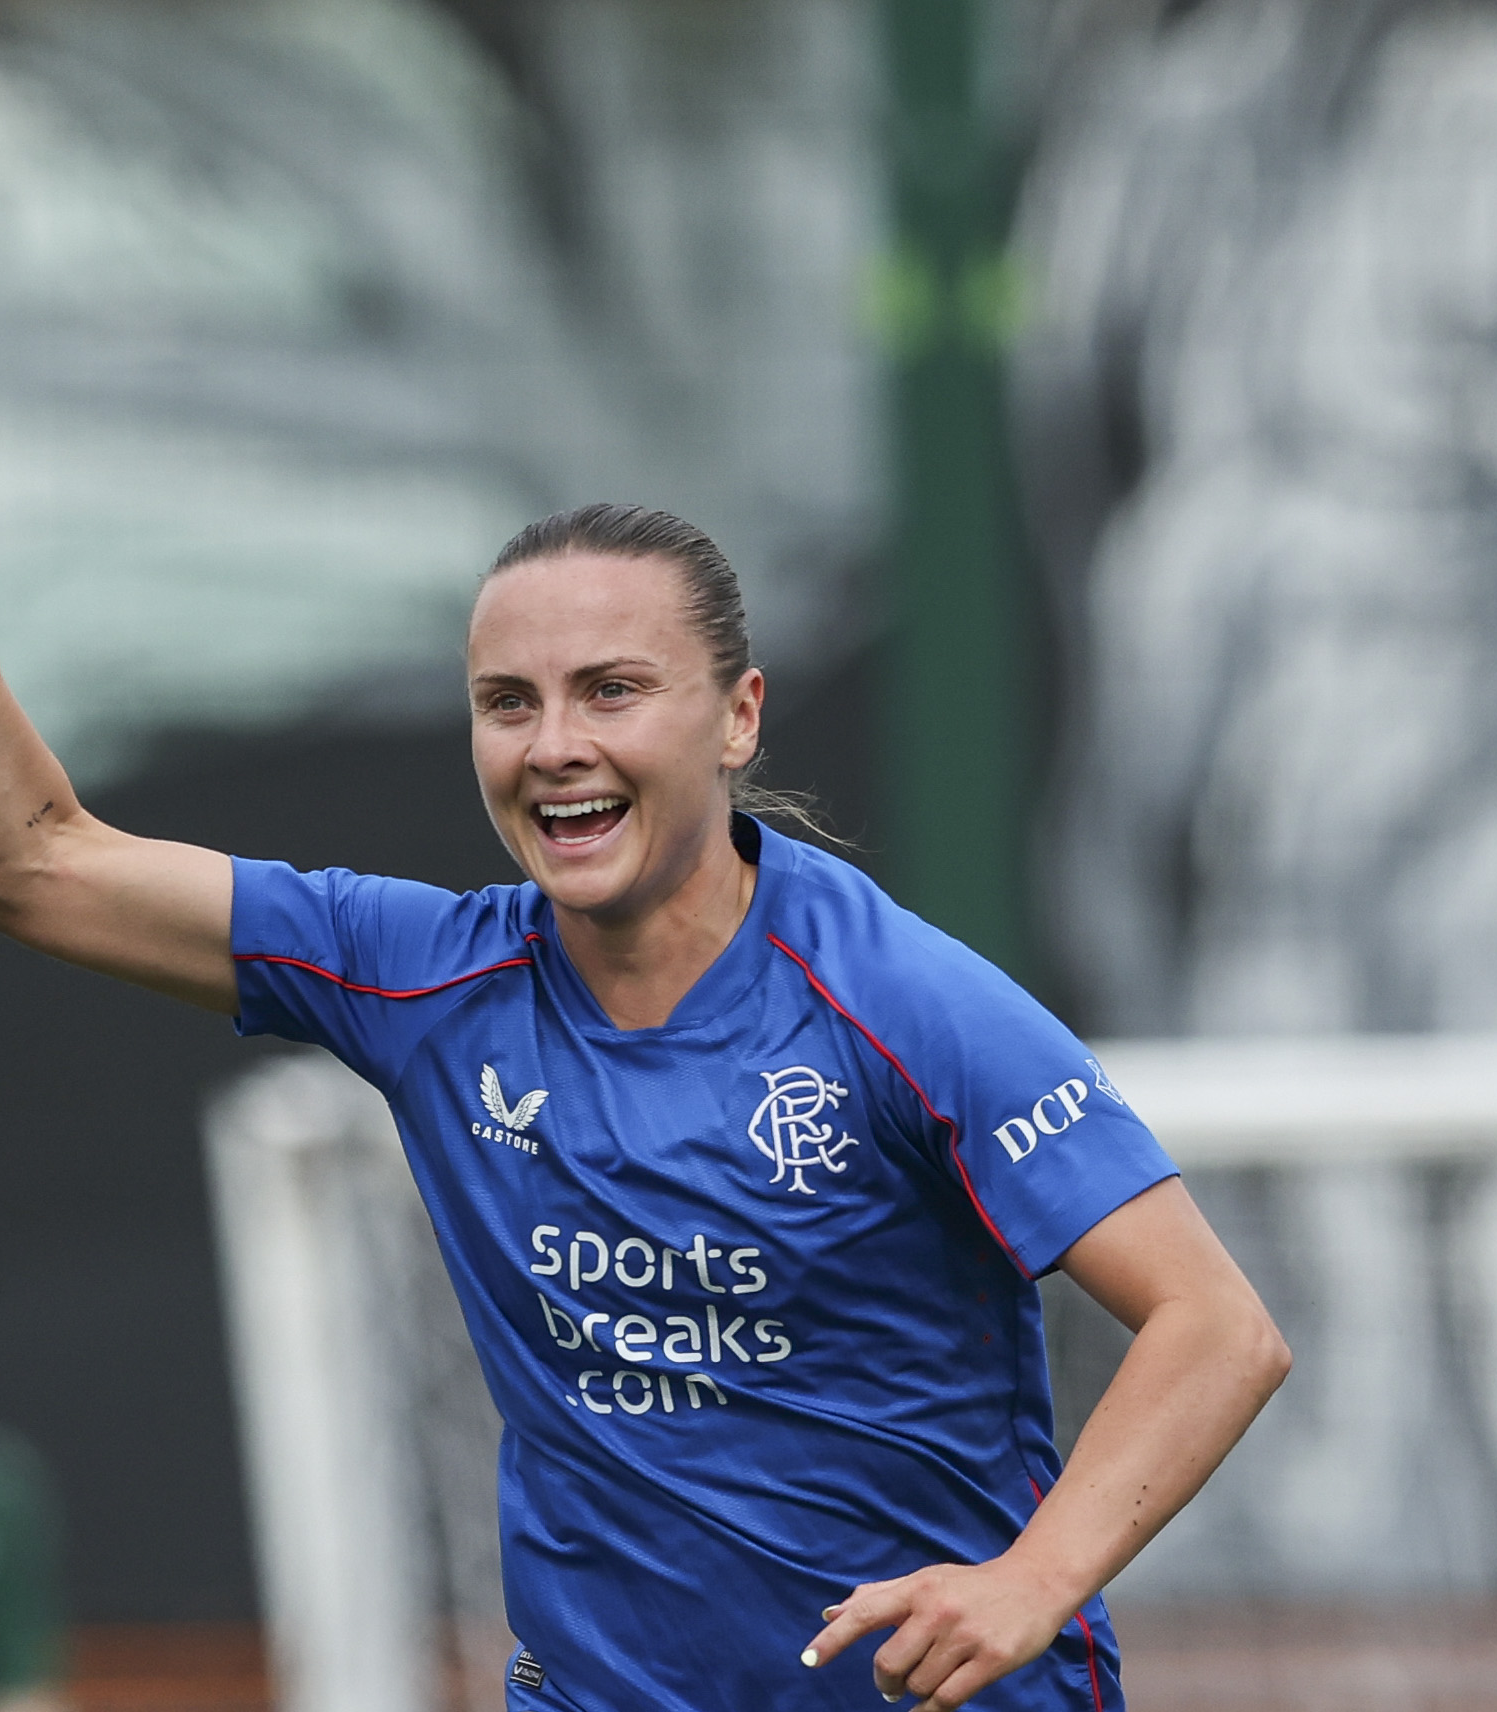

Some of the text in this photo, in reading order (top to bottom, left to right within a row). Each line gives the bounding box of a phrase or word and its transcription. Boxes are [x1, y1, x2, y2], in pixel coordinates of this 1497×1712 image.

[471, 1122, 539, 1155] CASTORE
[991, 1078, 1089, 1164] DCP
[530, 1224, 767, 1294] sports
[536, 1292, 792, 1363] breaks
